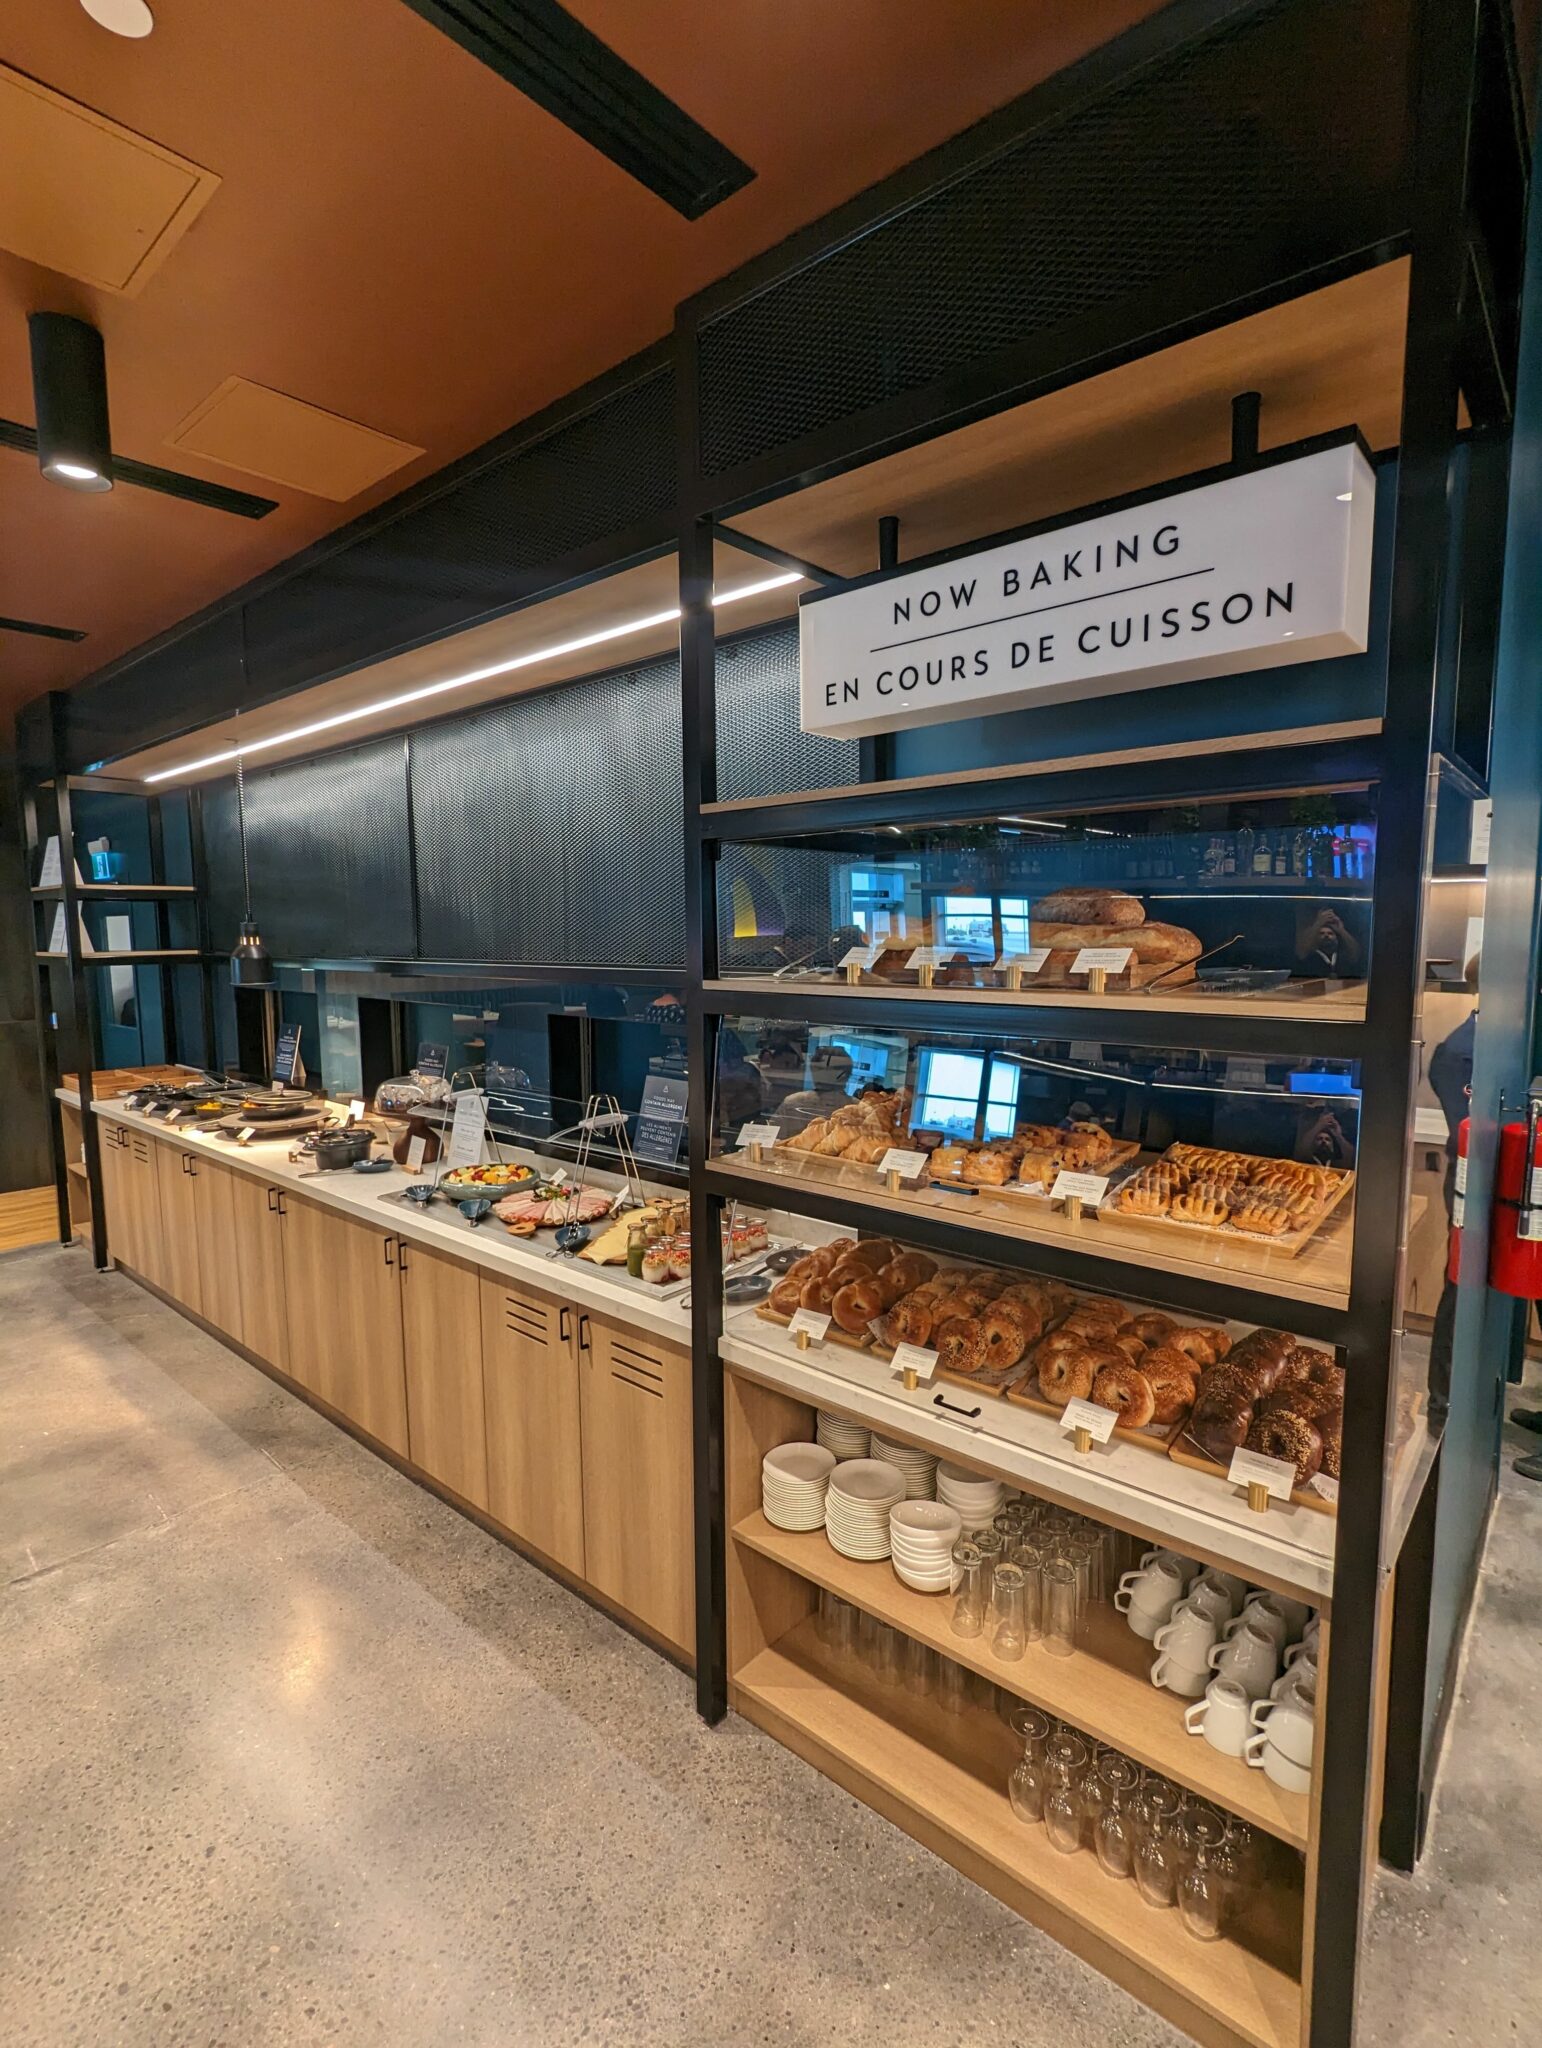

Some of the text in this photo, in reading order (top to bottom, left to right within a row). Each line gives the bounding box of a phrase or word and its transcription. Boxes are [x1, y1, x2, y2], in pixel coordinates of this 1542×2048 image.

[895, 525, 1180, 625] NOW BAKING
[825, 582, 1294, 707] EN COURS DE CUISSON
[644, 1098, 683, 1111] CONTAIN ALLERGENS
